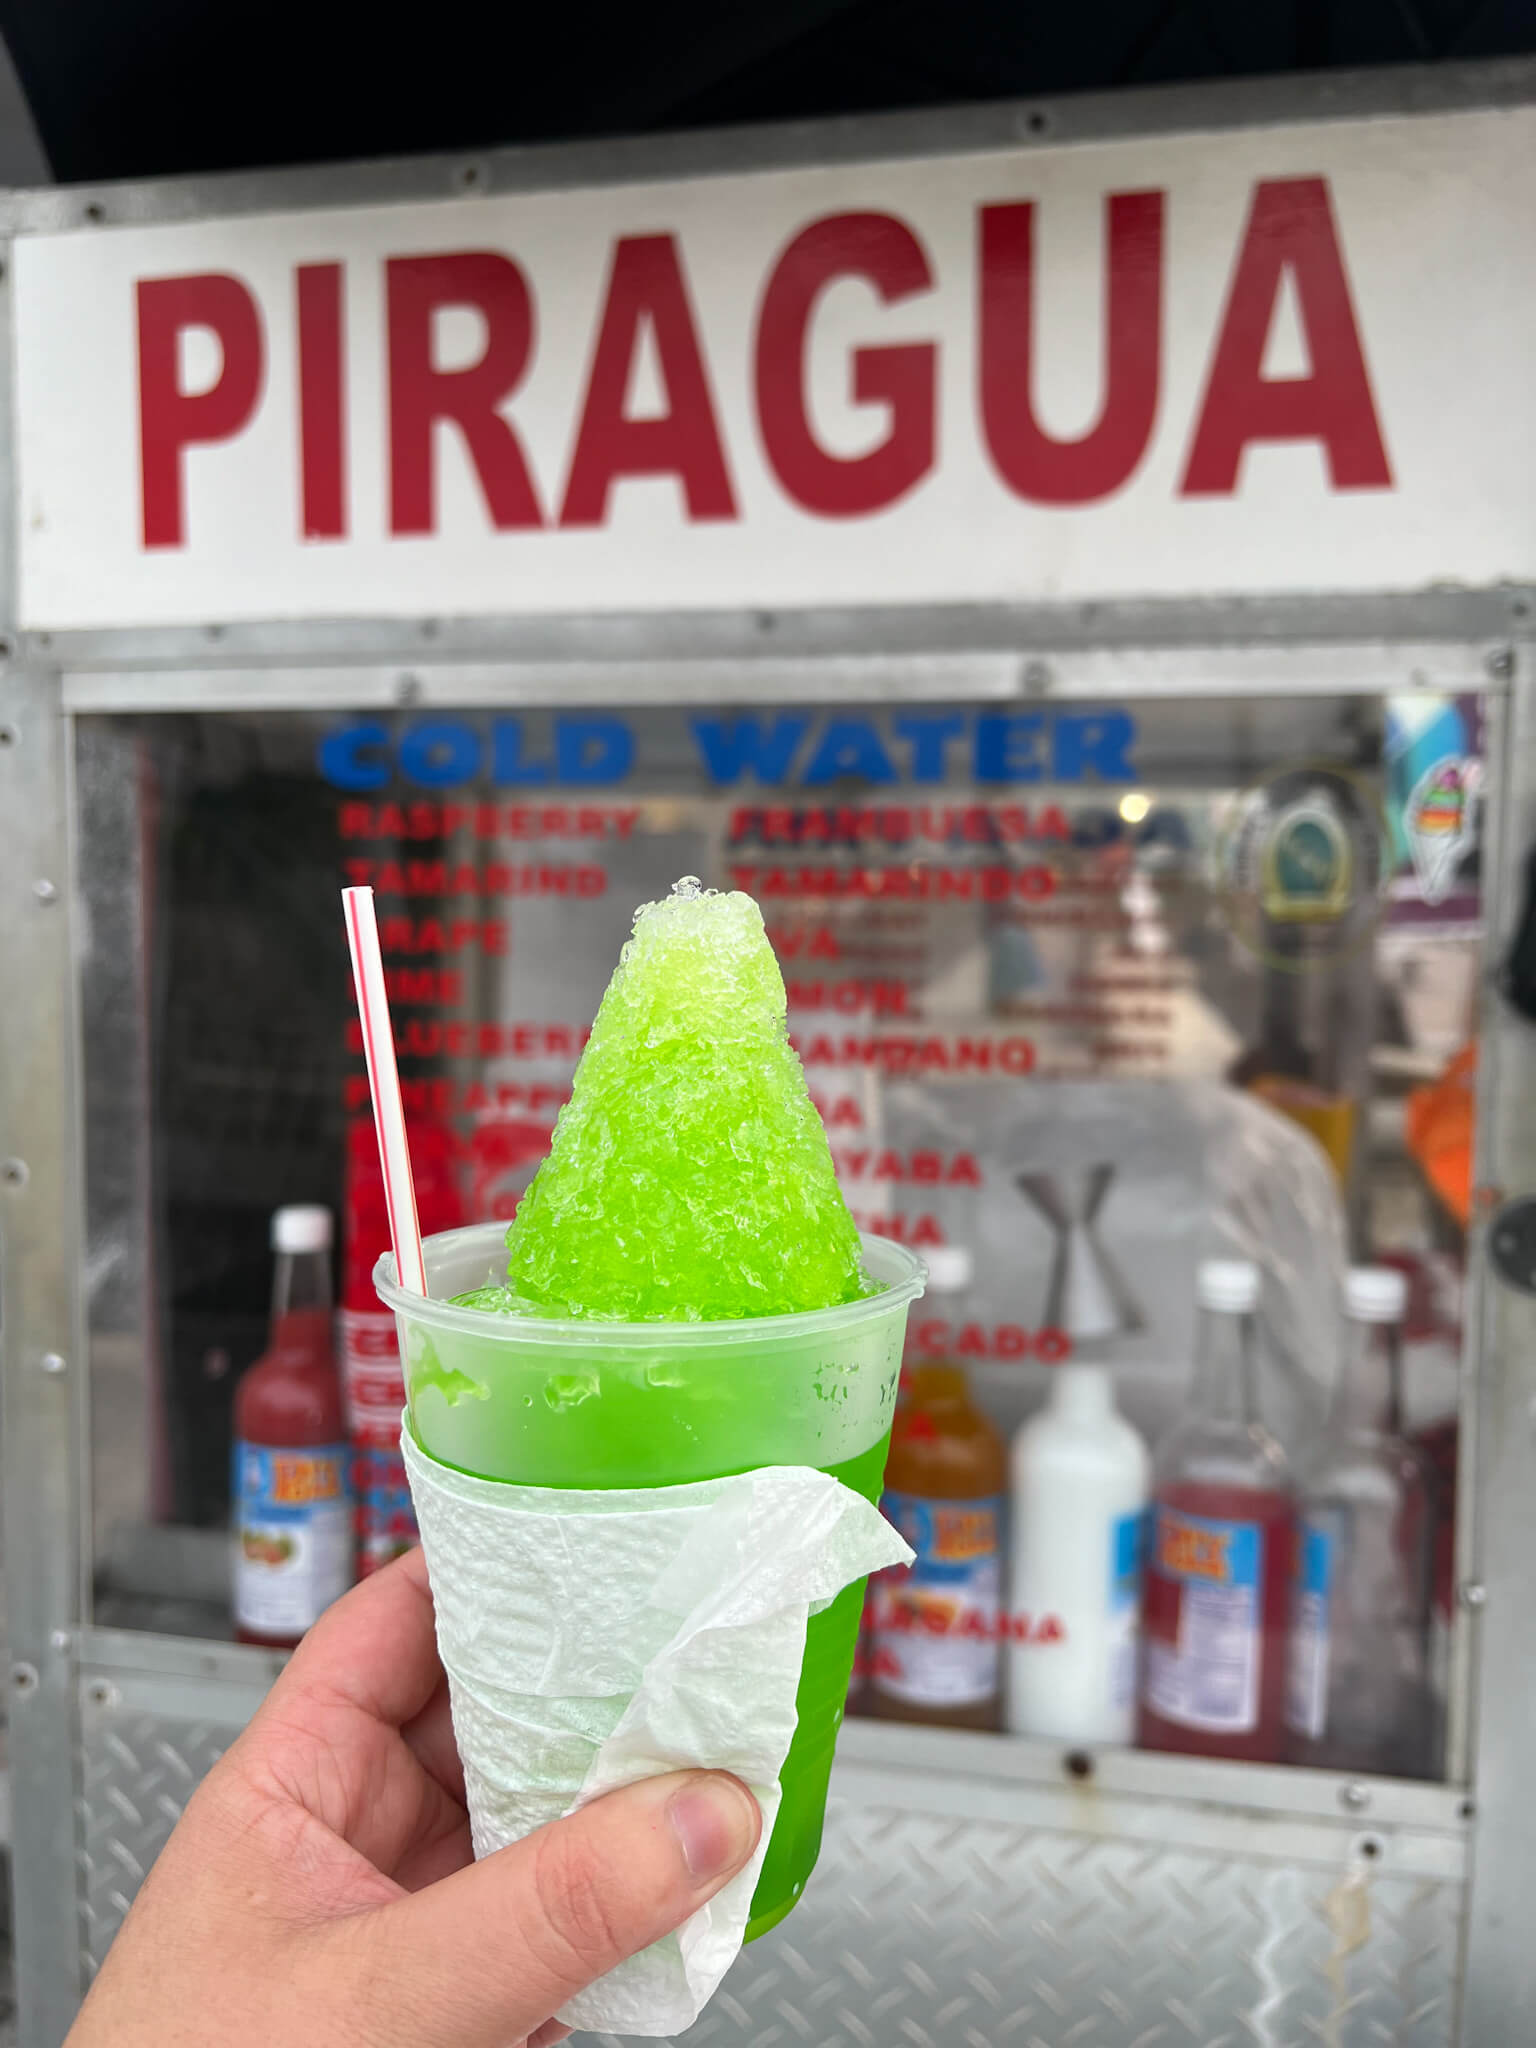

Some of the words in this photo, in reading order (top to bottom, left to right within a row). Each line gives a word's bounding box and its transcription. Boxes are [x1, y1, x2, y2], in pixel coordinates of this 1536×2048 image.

[135, 173, 1395, 551] PIRAGUA
[319, 715, 634, 791] COLD
[690, 712, 1136, 784] WATER
[338, 801, 641, 840] RASPBERRY
[730, 804, 1072, 843] FRAMBUESA
[343, 856, 607, 900] TAMARIND
[728, 864, 1057, 903] TAMARINDO
[376, 917, 508, 957] RAPE
[772, 924, 841, 964] VA
[350, 967, 463, 1005] IME
